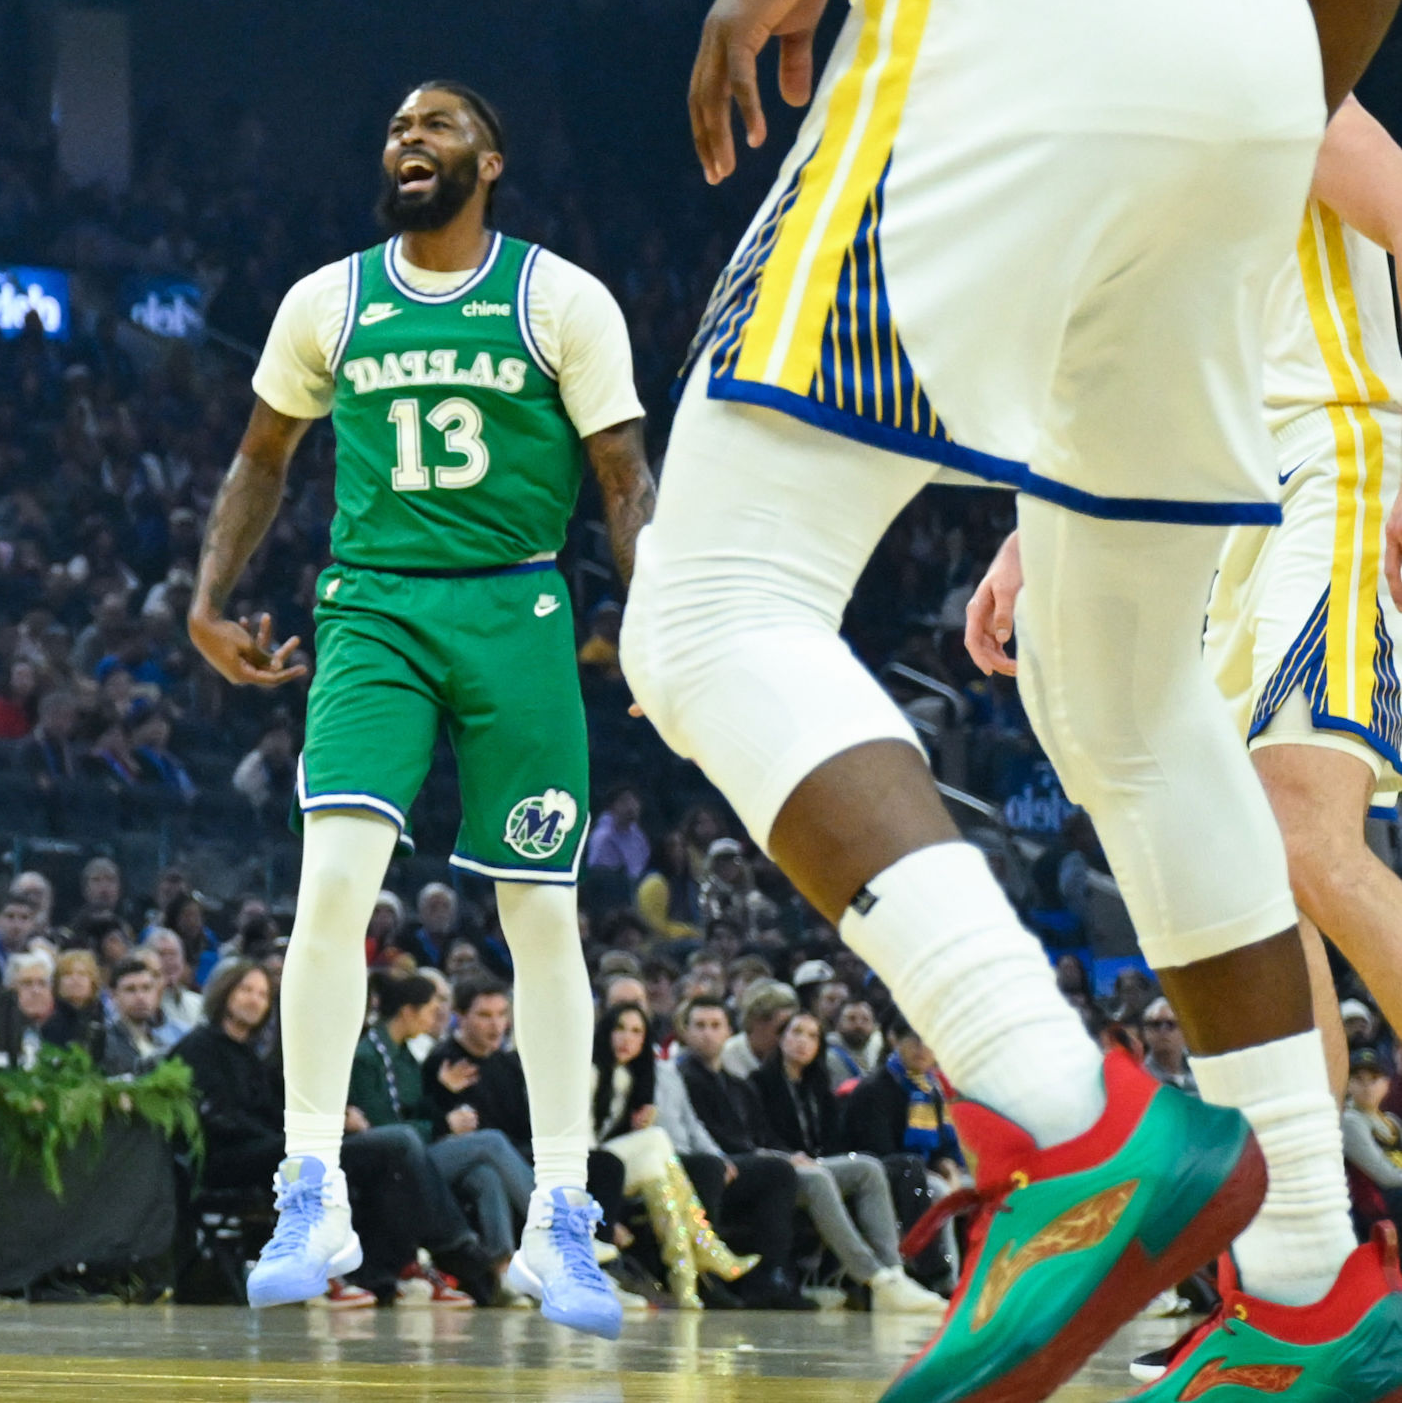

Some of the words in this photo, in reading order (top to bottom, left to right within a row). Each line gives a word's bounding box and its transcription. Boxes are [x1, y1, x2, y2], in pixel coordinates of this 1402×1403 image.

[461, 300, 512, 318] chime
[343, 348, 529, 395] DALLAS
[386, 396, 491, 492] 13
